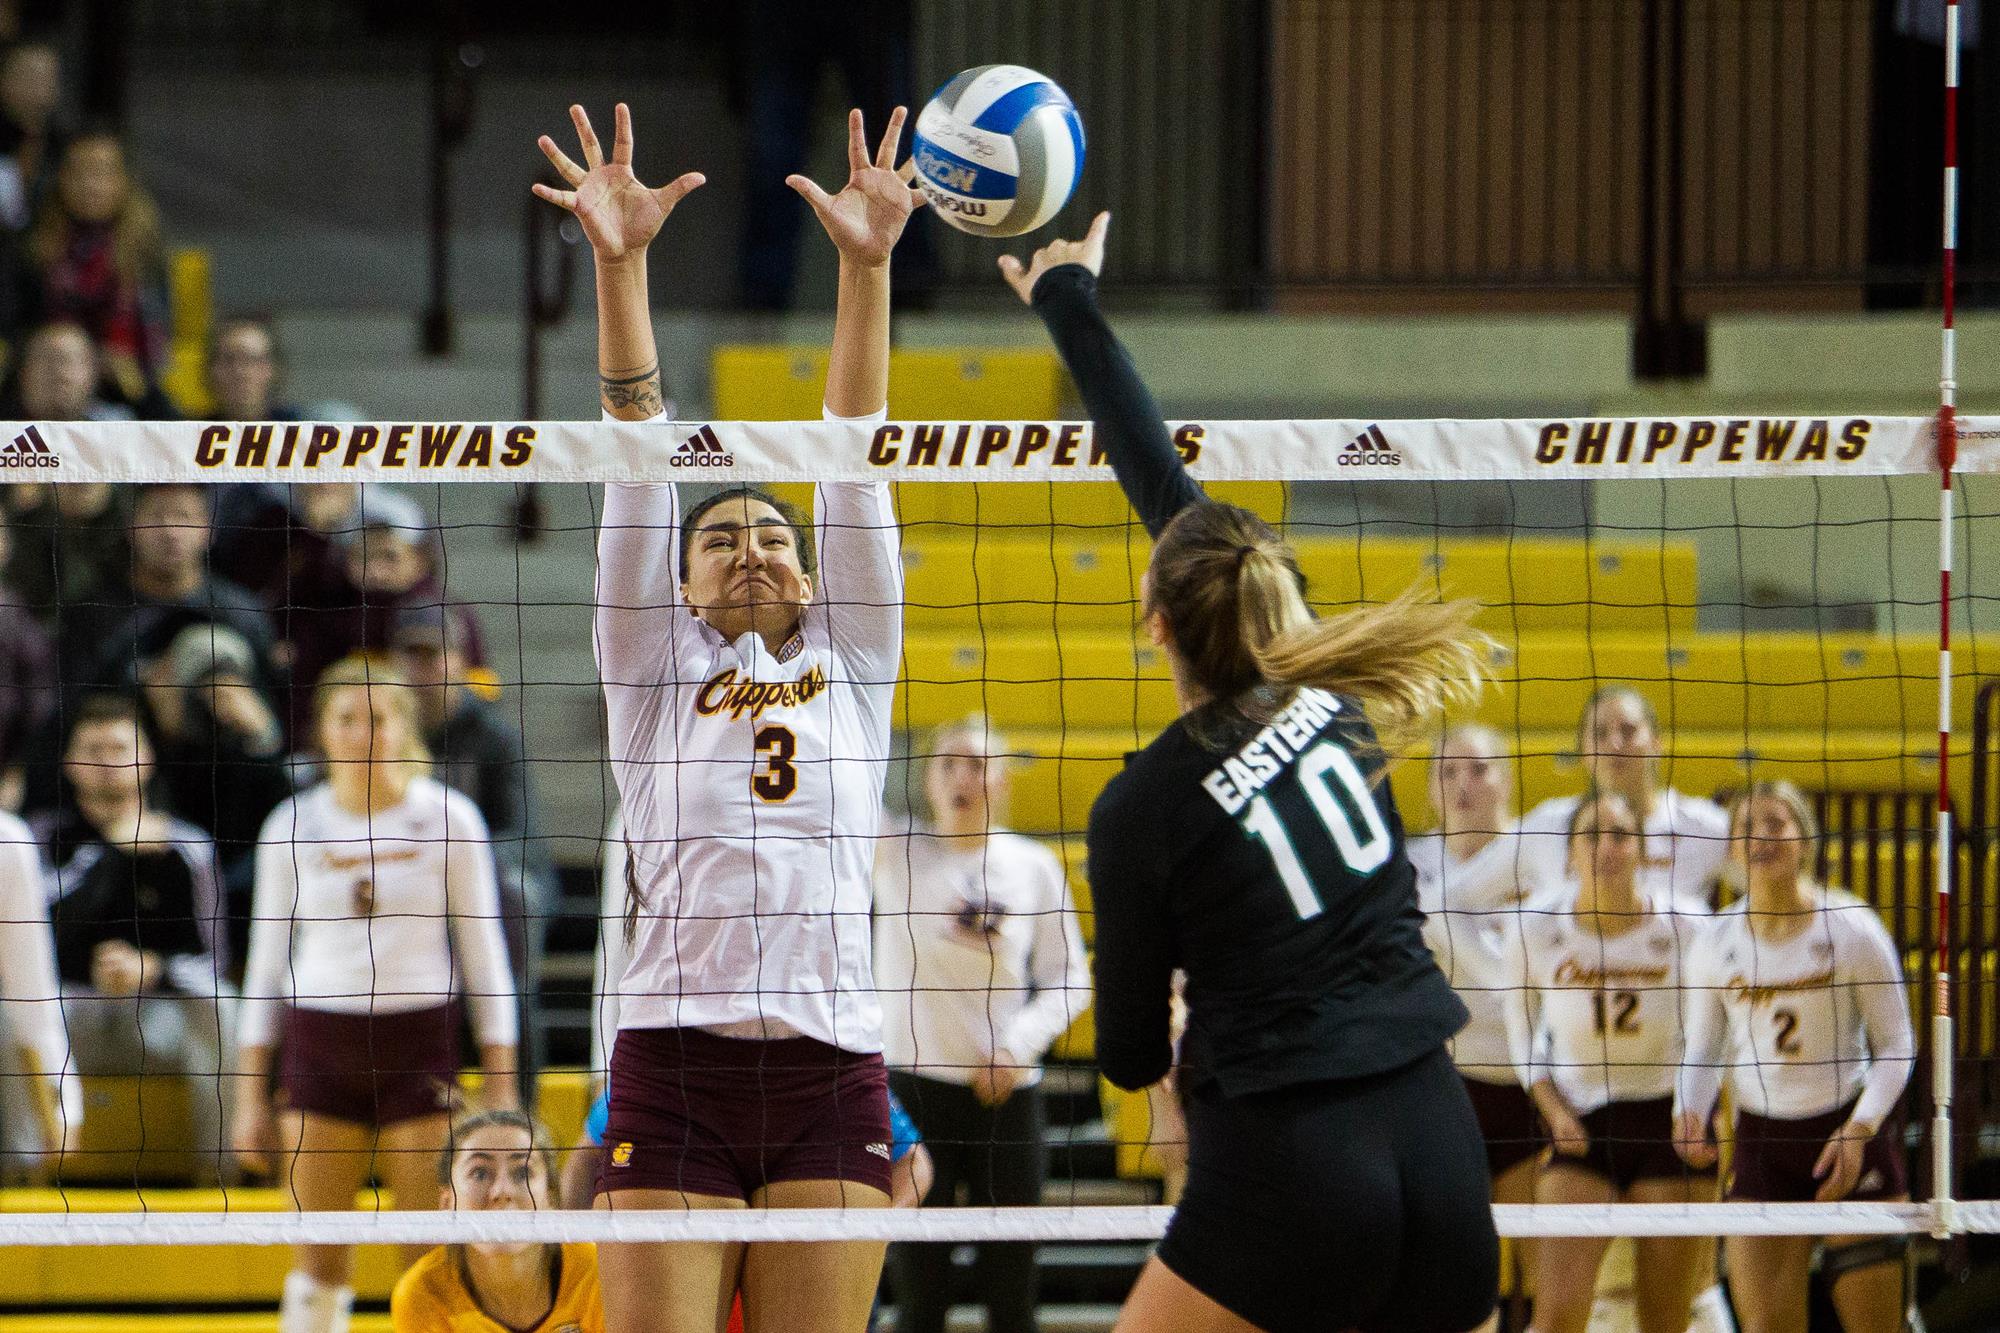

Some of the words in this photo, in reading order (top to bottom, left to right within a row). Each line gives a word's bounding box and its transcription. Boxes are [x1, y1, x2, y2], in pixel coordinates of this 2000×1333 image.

[0, 453, 60, 468] adidas
[195, 425, 536, 469] CHIPPEWAS
[670, 452, 734, 467] adidas
[868, 425, 1205, 468] CHIPPES
[1337, 451, 1401, 466] adidas
[1535, 420, 1872, 465] CHIPPEWAS
[752, 724, 799, 804] 3
[1200, 685, 1342, 816] EASTERN
[1239, 738, 1392, 922] 10
[1592, 989, 1642, 1038] 12
[1772, 1007, 1801, 1058] 2
